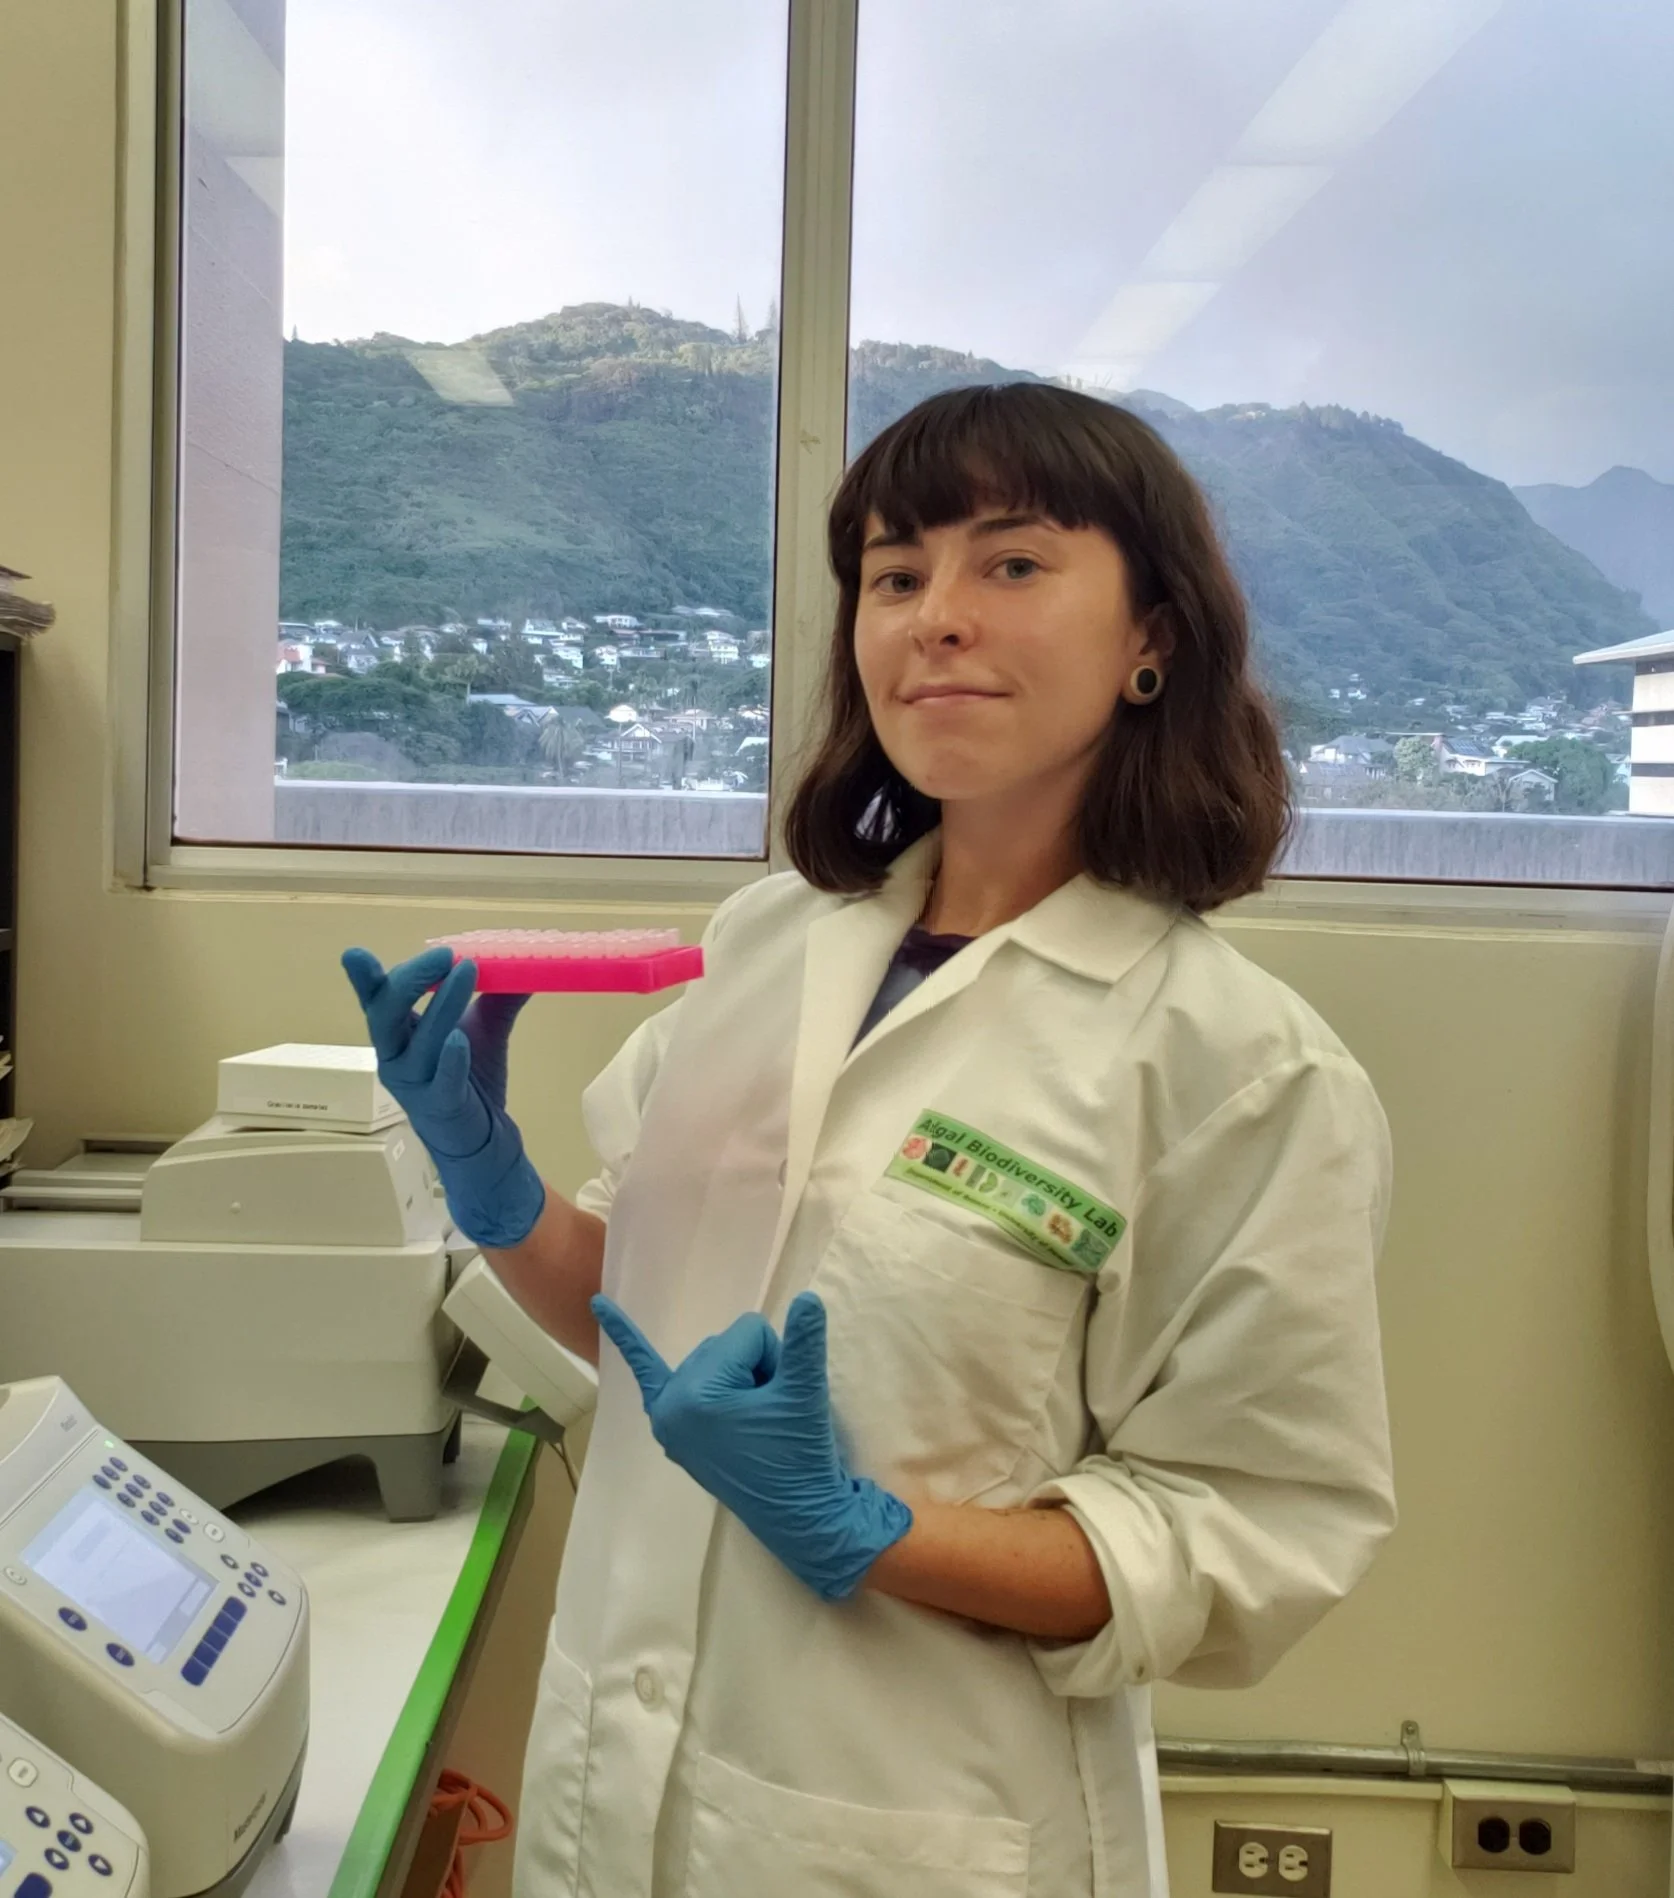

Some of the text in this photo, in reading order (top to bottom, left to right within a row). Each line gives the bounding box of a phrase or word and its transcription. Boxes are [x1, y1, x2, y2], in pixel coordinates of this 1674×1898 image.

[917, 1118, 967, 1144] Algal
[966, 1139, 1082, 1210] Biodiversity
[1084, 1207, 1119, 1238] Lab
